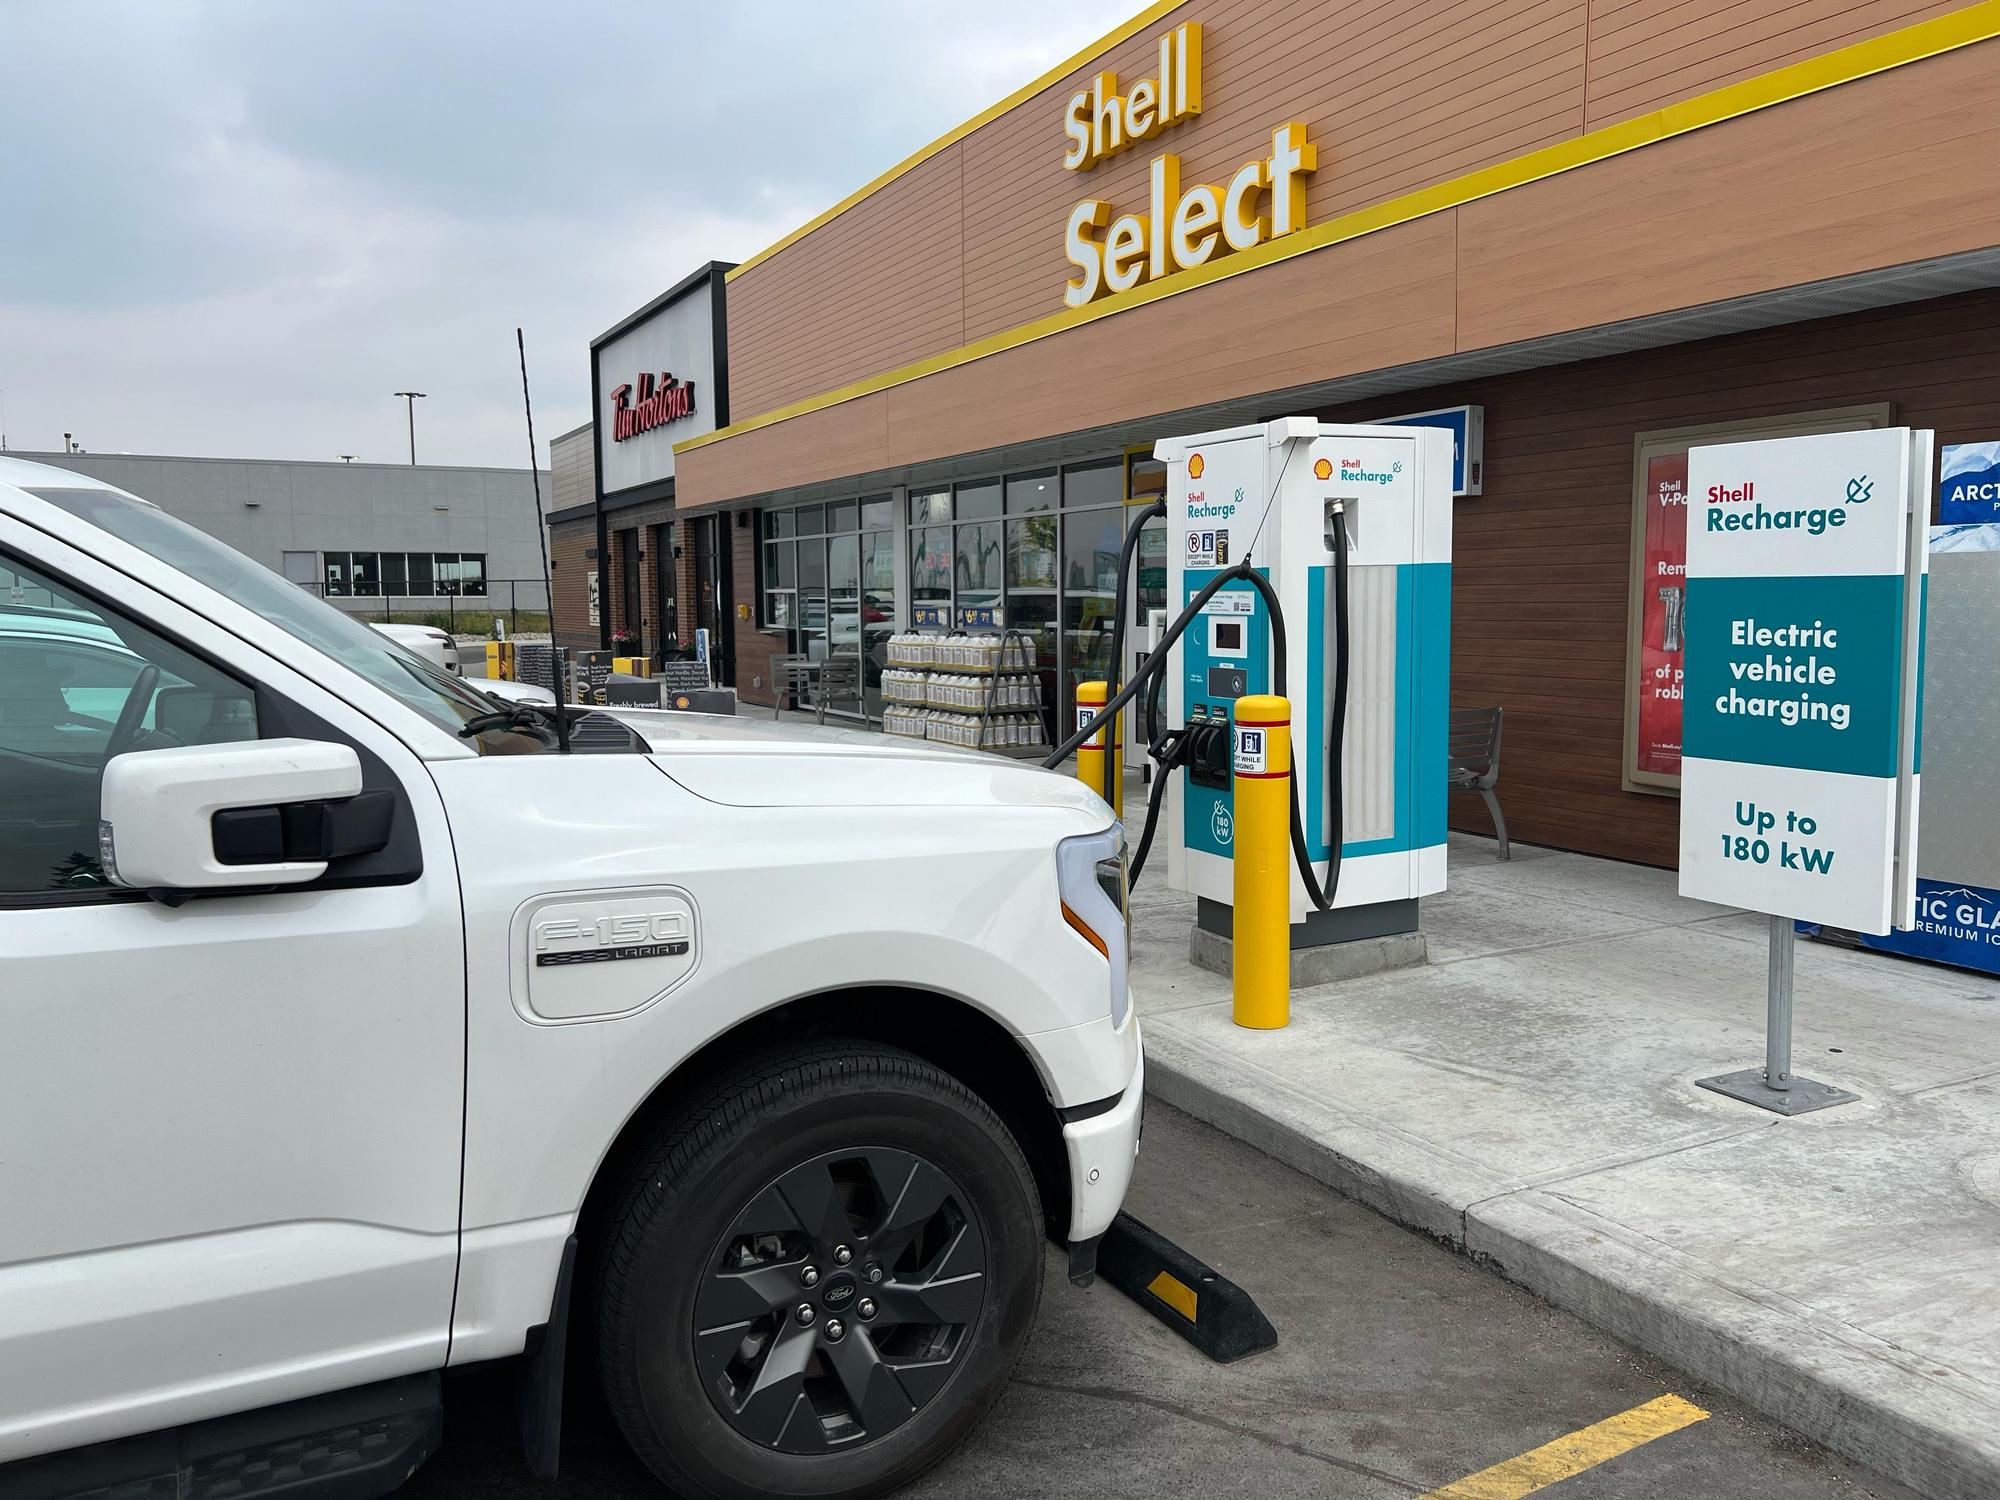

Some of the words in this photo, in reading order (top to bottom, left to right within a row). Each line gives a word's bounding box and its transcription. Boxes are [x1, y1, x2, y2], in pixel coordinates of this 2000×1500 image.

[1063, 22, 1202, 171] Shell
[1063, 122, 1317, 308] Select
[611, 384, 637, 442] Tim
[635, 372, 696, 434] Hortons
[1341, 459, 1361, 468] Shell
[1341, 469, 1393, 485] Recharge
[1660, 480, 1681, 492] Shell
[1188, 491, 1205, 502] Shell
[1707, 482, 1754, 503] Shell
[1188, 502, 1236, 519] Recharge
[1707, 503, 1846, 535] Recharge
[1732, 619, 1838, 648] Electric
[1655, 664, 1671, 678] of
[1729, 655, 1836, 684] vehicle
[633, 700, 659, 708] brewed
[1715, 688, 1851, 730] charging
[1216, 816, 1229, 828] 180
[1735, 801, 1775, 835] Up
[1786, 810, 1817, 835] to
[1216, 825, 1229, 837] kW
[1721, 834, 1769, 864] 180
[1780, 841, 1835, 875] kW
[536, 911, 688, 950] F-150
[615, 944, 682, 958] LARIAT
[830, 1287, 849, 1300] Ford
